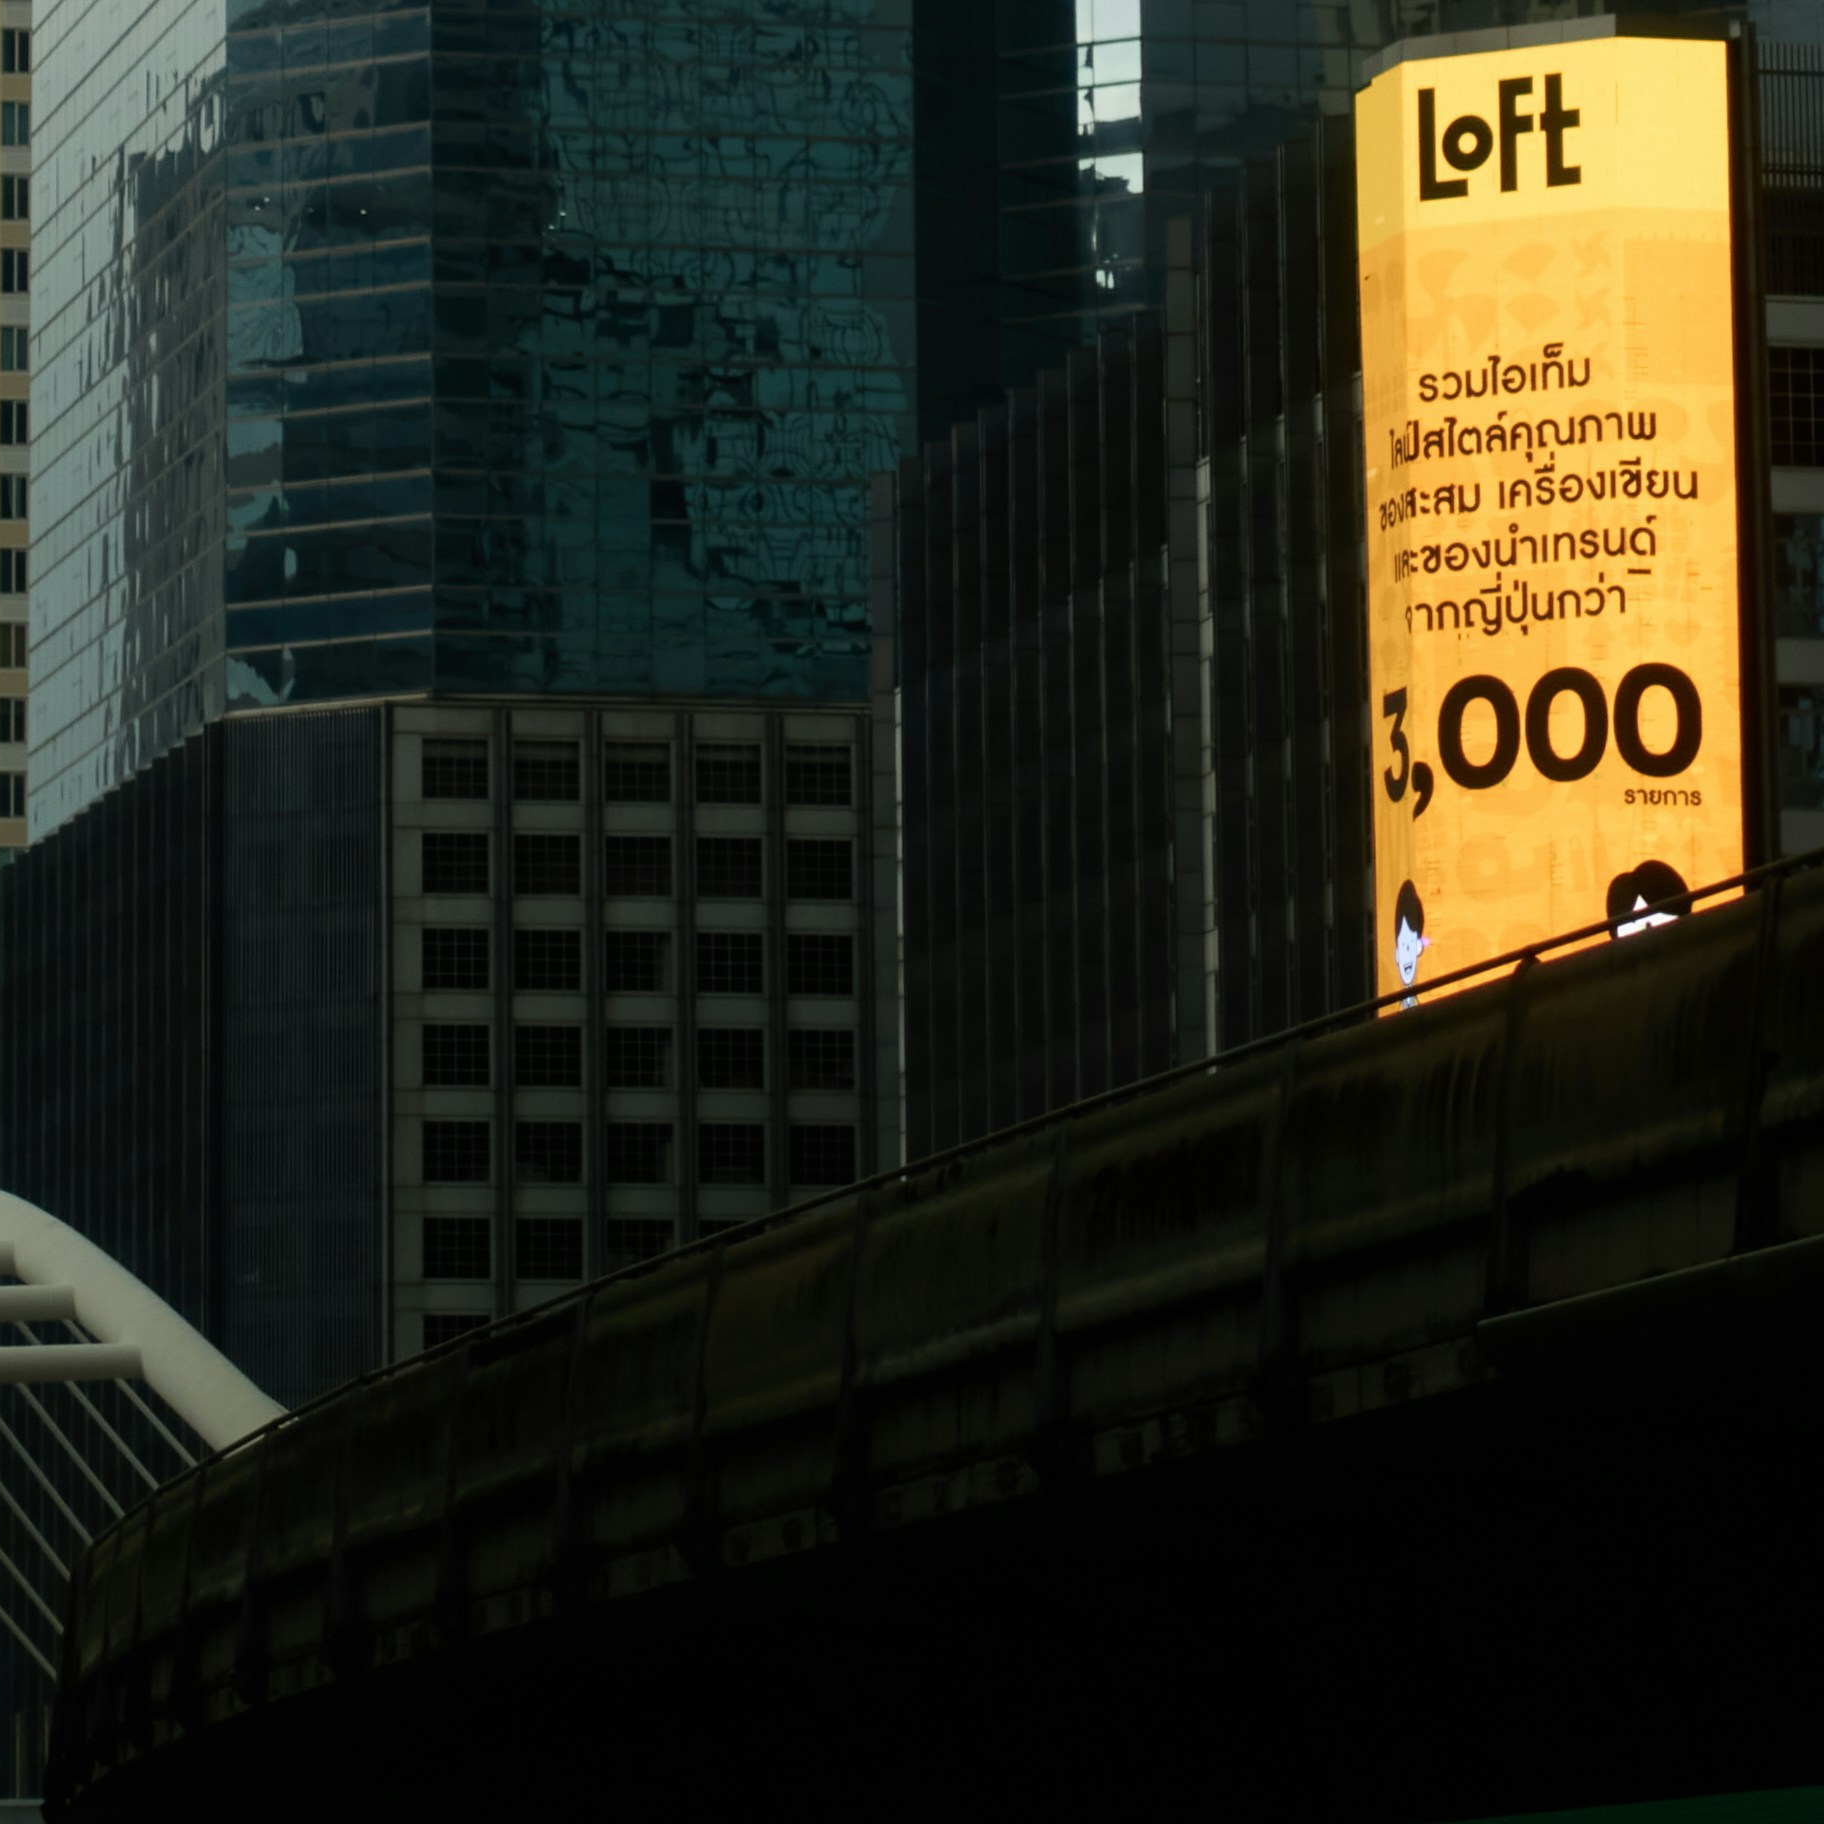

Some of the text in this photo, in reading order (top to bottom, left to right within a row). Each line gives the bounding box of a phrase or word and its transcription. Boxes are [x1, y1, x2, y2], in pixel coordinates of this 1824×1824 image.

[1418, 342, 1591, 403] รวมไอเท็ม
[1379, 451, 1698, 532] ของสะสม เครื่องเขียน
[1383, 662, 1702, 822] 3,000
[1624, 788, 1702, 806] รายการ
